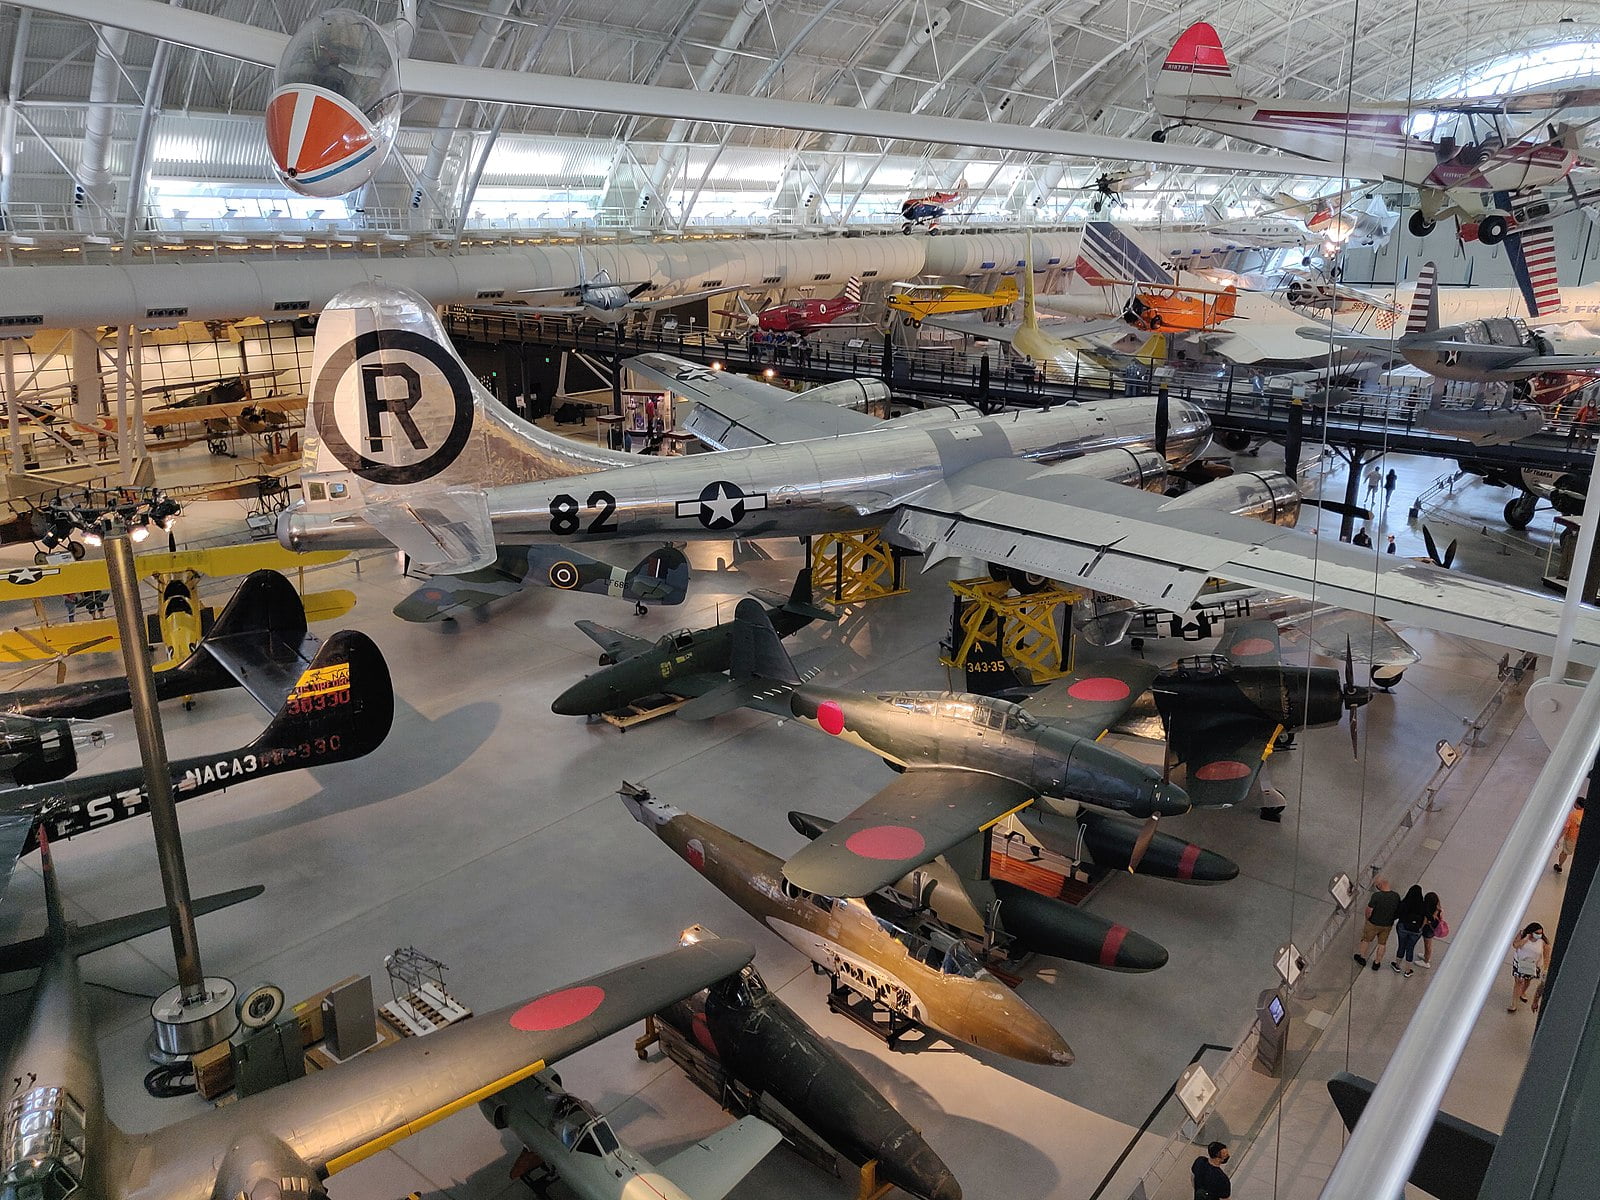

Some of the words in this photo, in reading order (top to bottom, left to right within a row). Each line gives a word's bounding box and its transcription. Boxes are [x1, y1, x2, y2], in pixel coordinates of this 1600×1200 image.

[361, 362, 429, 453] R
[549, 490, 618, 536] 82
[974, 641, 983, 653] A
